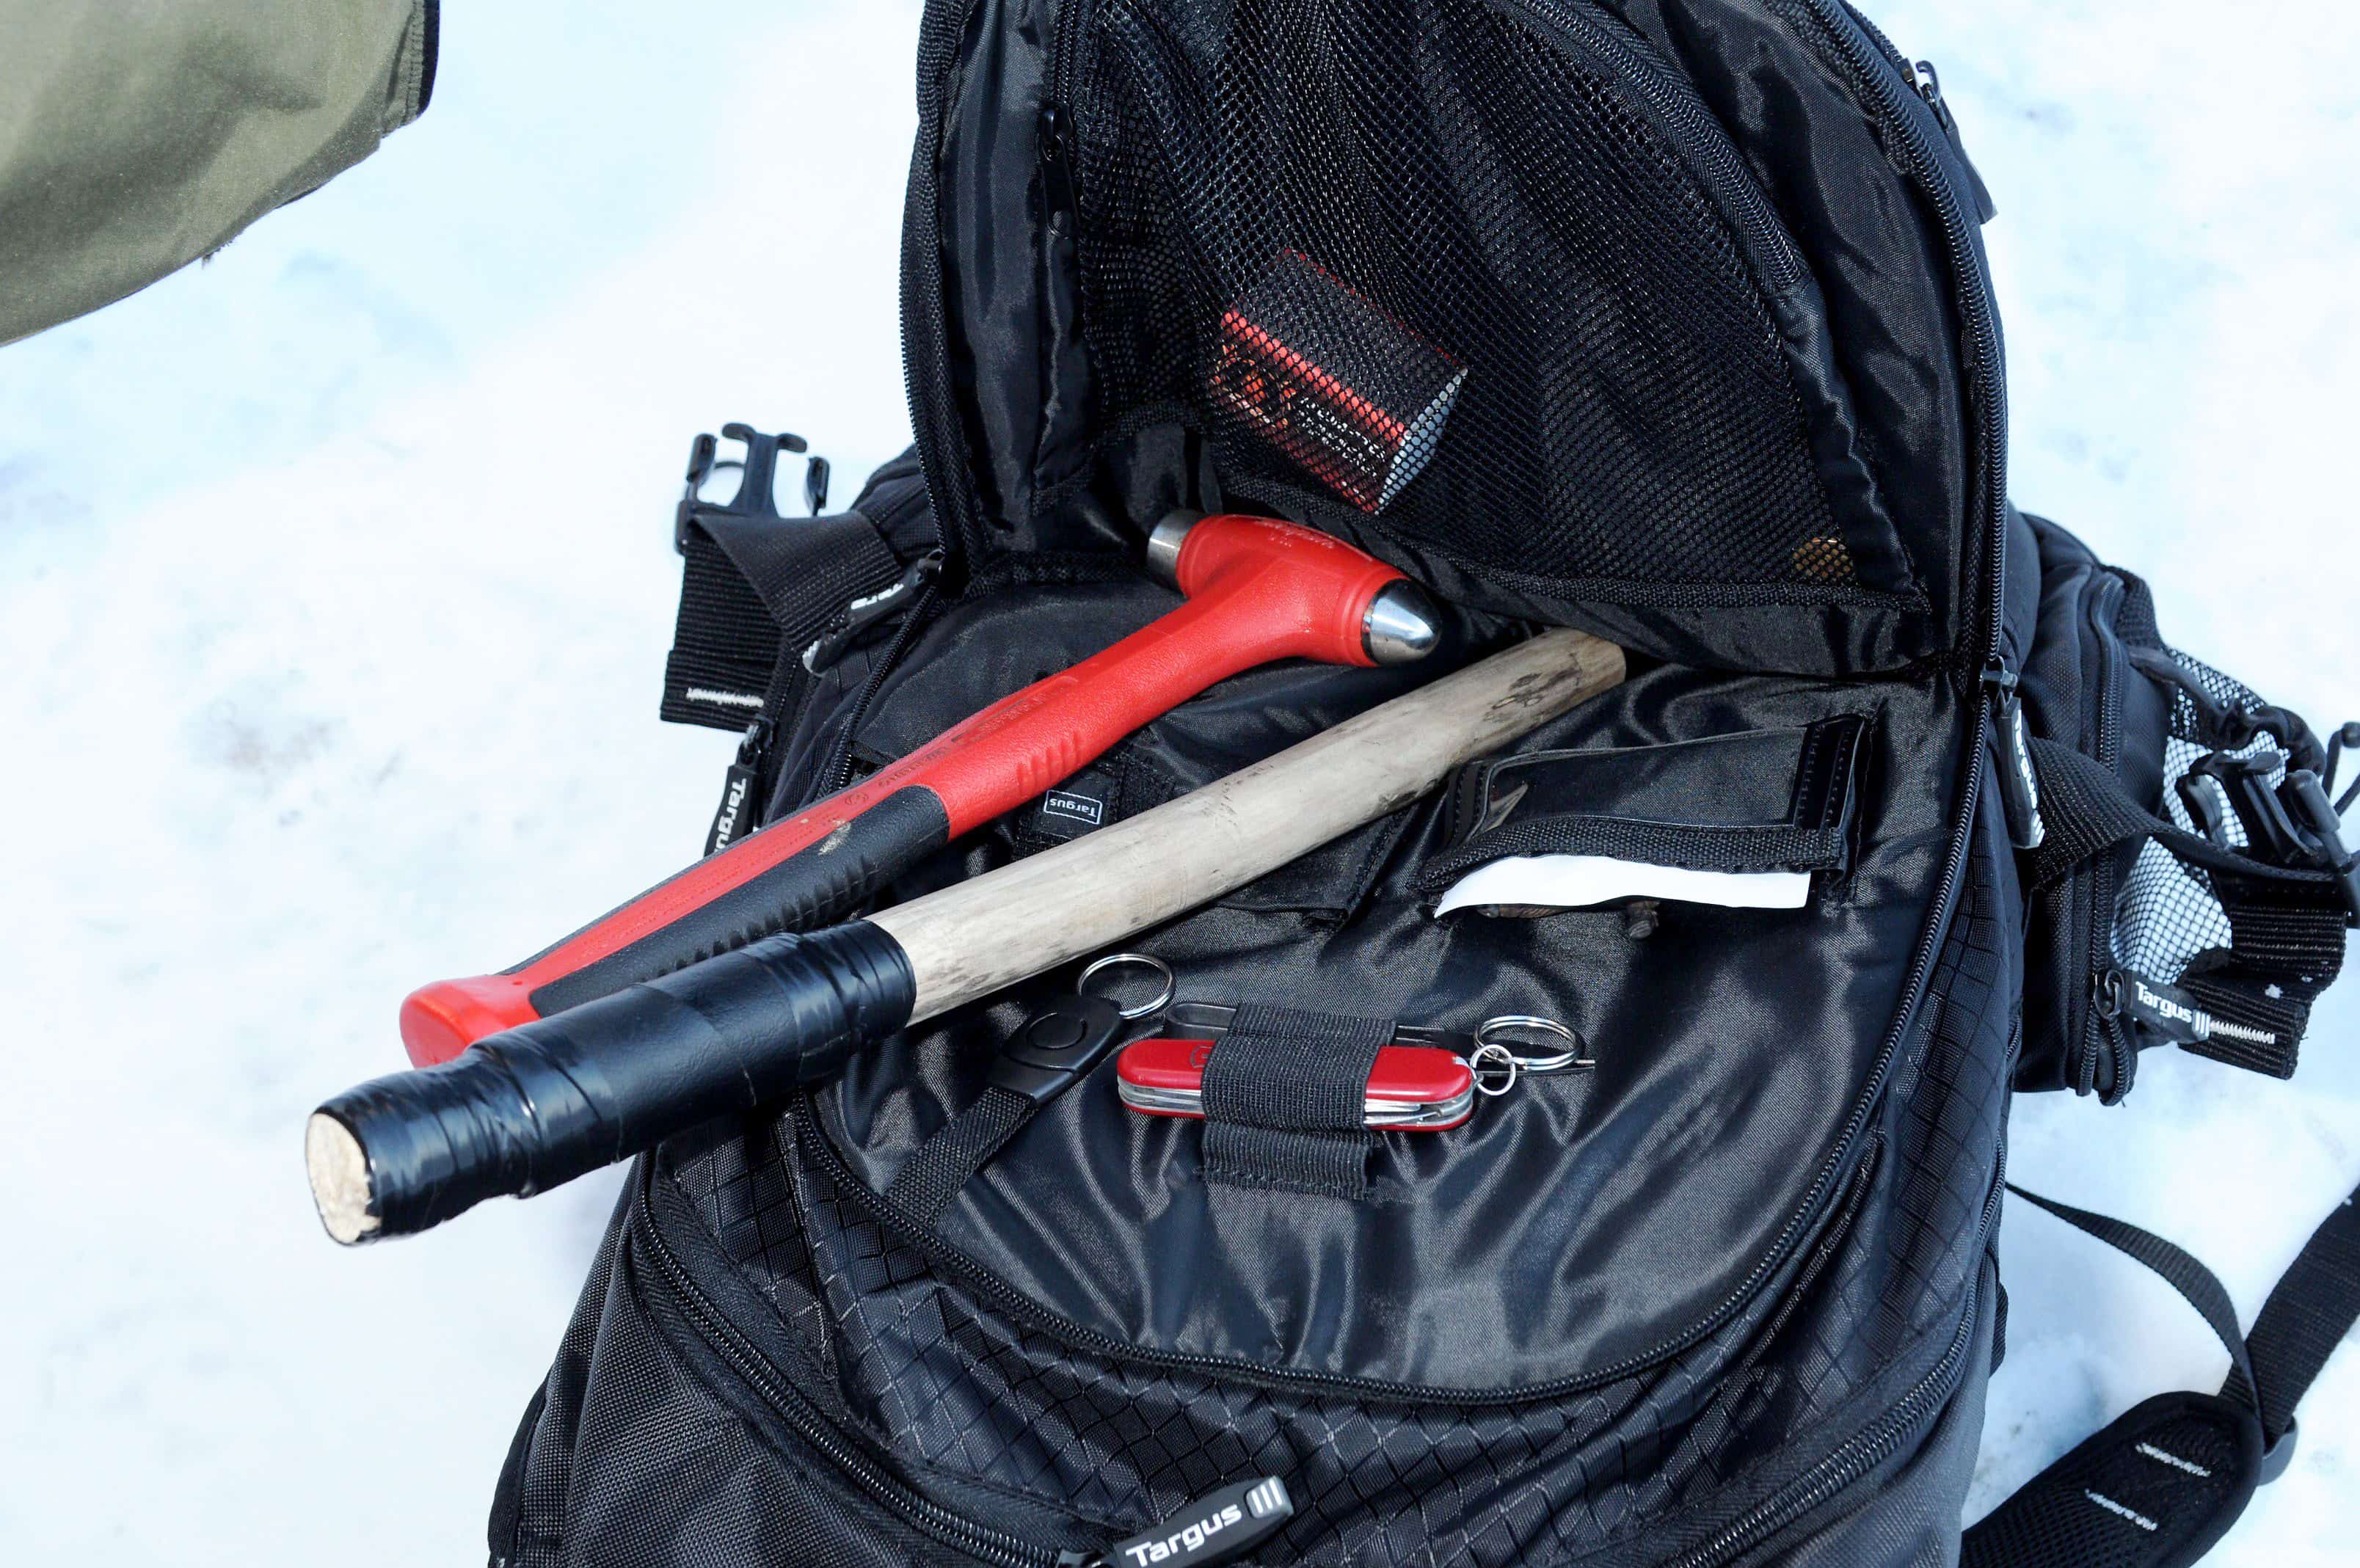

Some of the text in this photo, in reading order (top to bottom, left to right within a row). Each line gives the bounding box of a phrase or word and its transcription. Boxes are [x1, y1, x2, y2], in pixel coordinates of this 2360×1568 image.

[714, 778, 747, 852] Targu
[1049, 798, 1096, 817] Targus
[2135, 981, 2193, 1023] Targus
[1125, 1503, 1242, 1567] Targus
